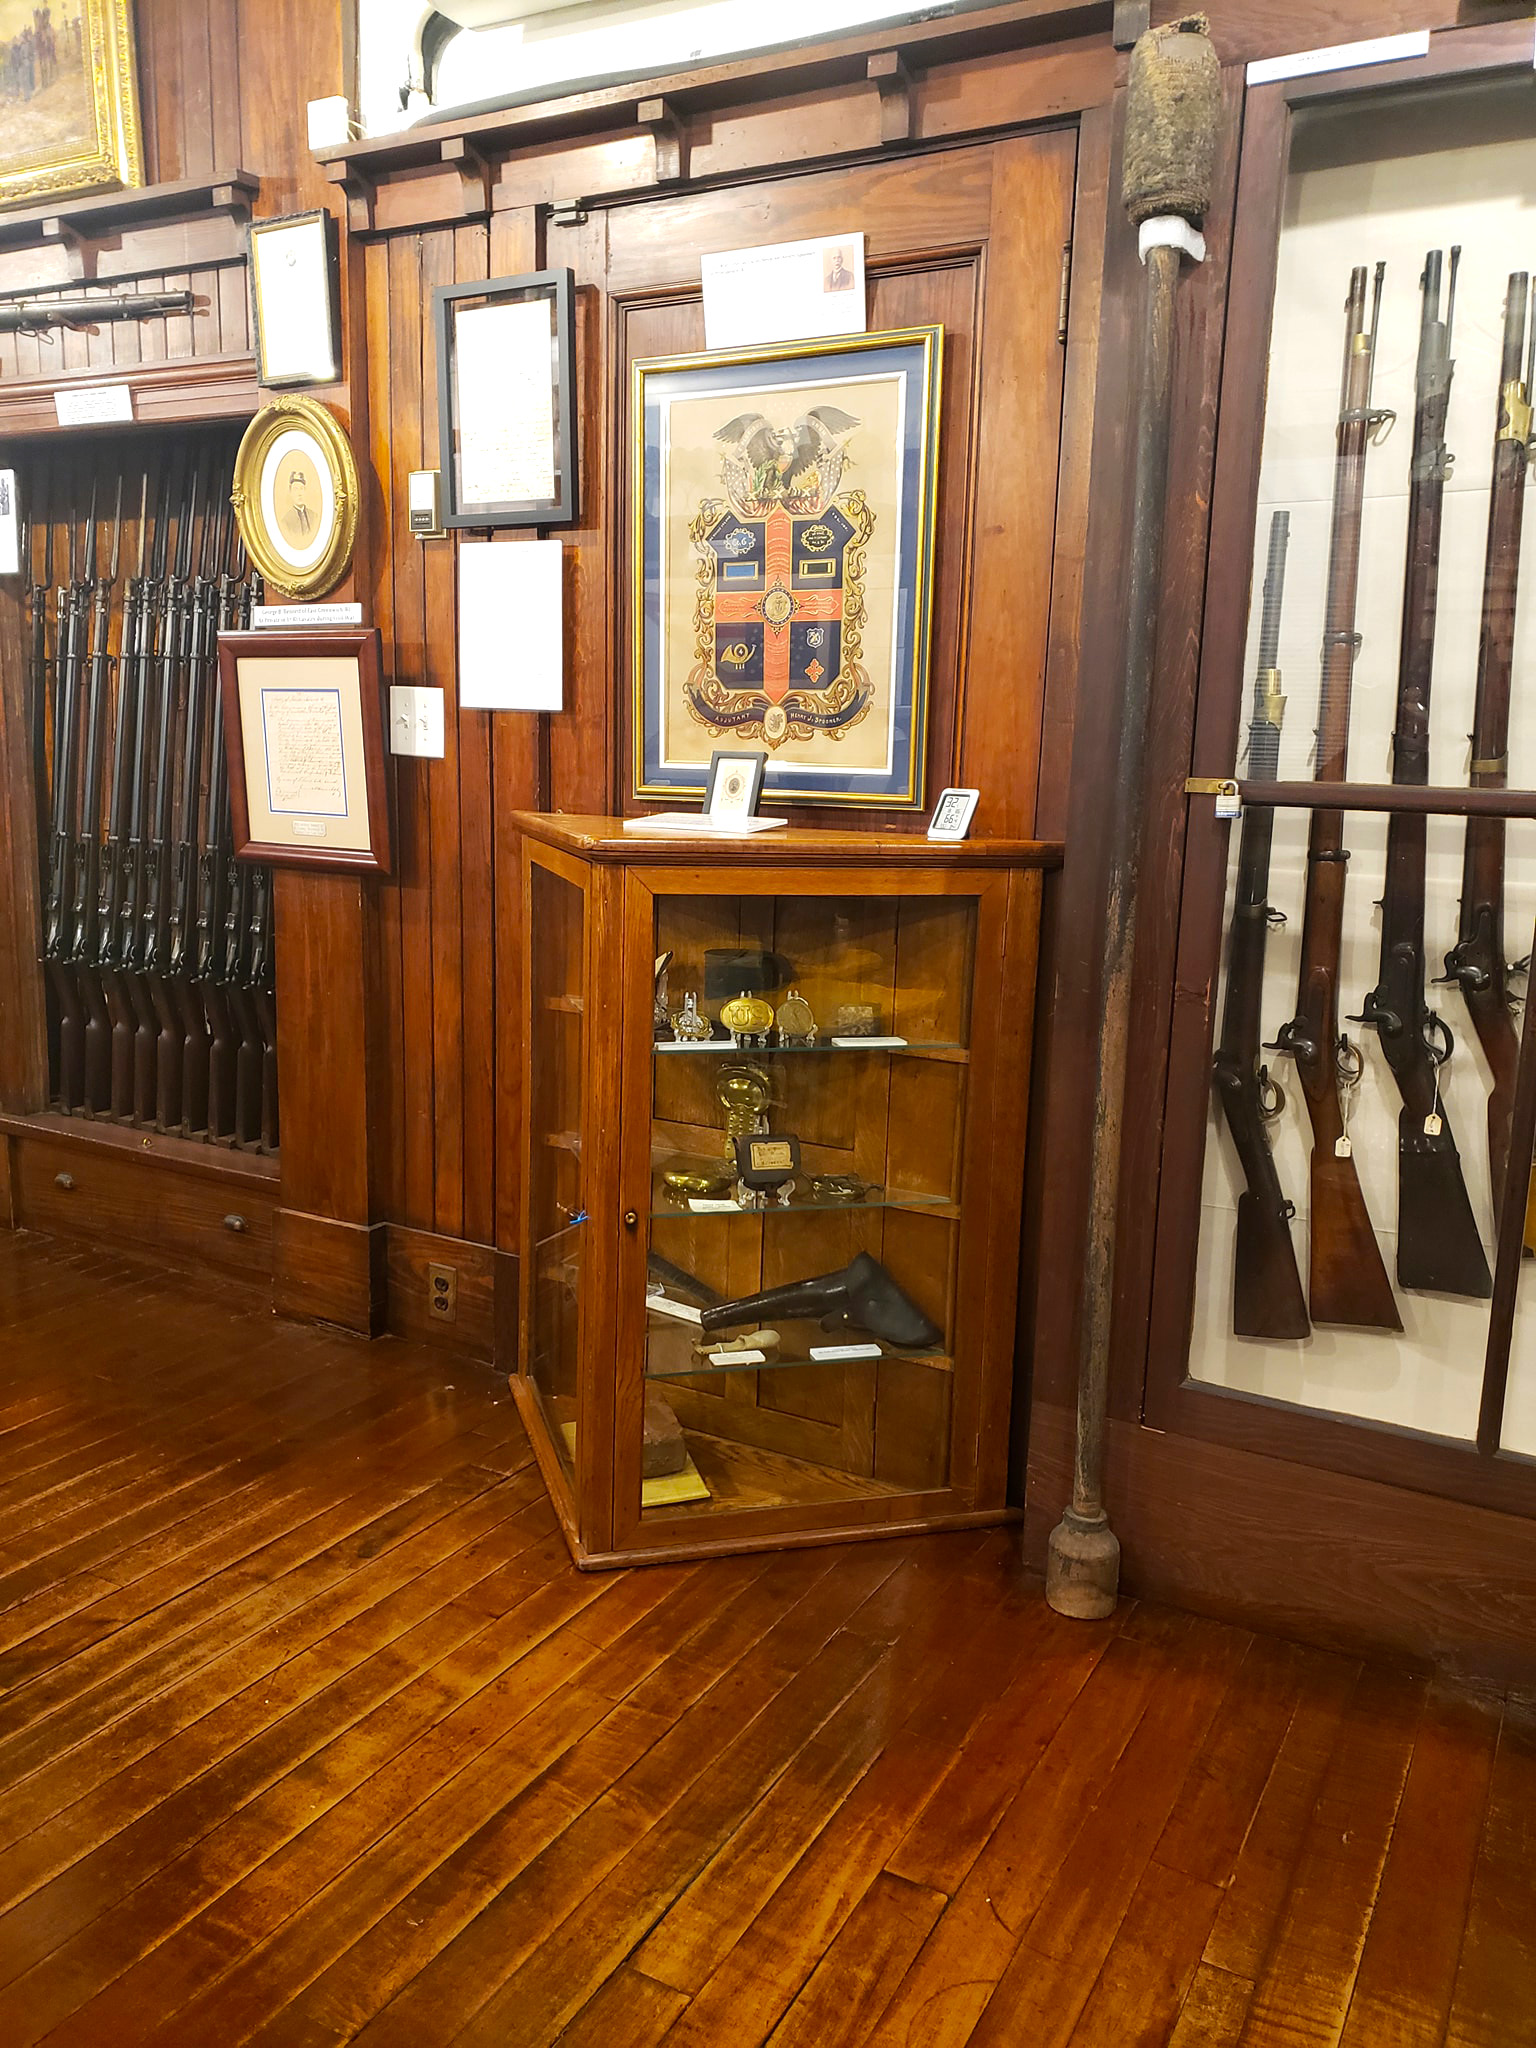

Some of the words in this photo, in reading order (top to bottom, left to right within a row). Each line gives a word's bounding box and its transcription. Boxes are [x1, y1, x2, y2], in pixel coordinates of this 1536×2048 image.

[945, 797, 959, 807] 32
[943, 814, 955, 823] 66
[729, 1005, 770, 1027] US
